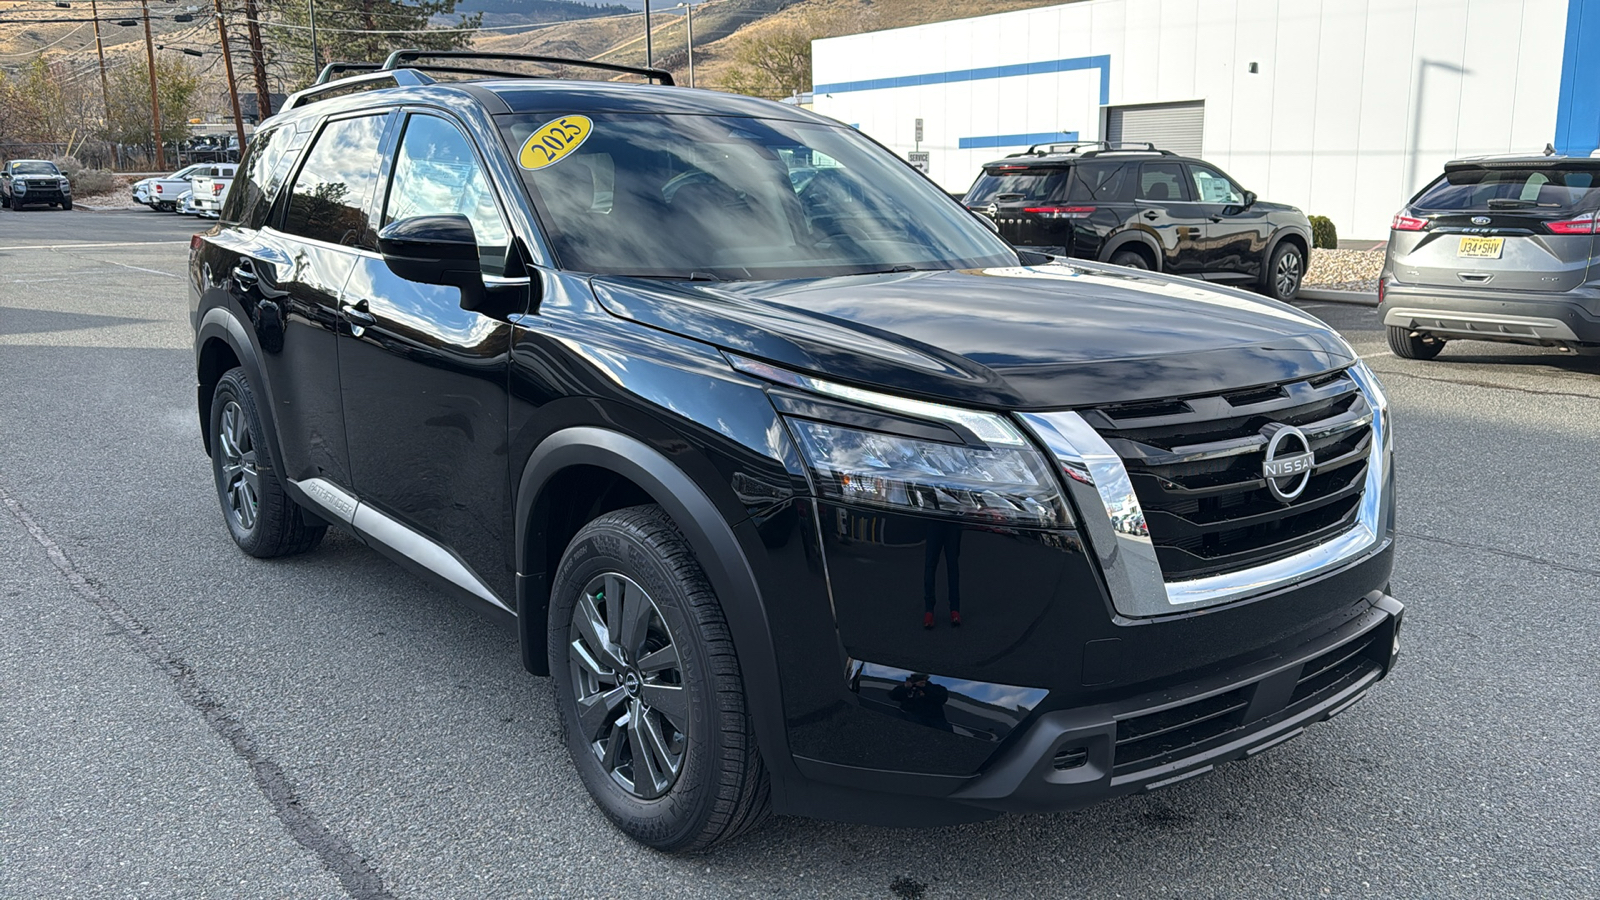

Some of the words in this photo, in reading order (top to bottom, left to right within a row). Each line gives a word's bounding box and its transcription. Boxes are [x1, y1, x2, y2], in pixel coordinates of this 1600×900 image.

[531, 119, 581, 161] 2025
[909, 153, 928, 162] SERVICE
[1265, 456, 1314, 476] NISSAN
[308, 482, 353, 517] PATHFINDER
